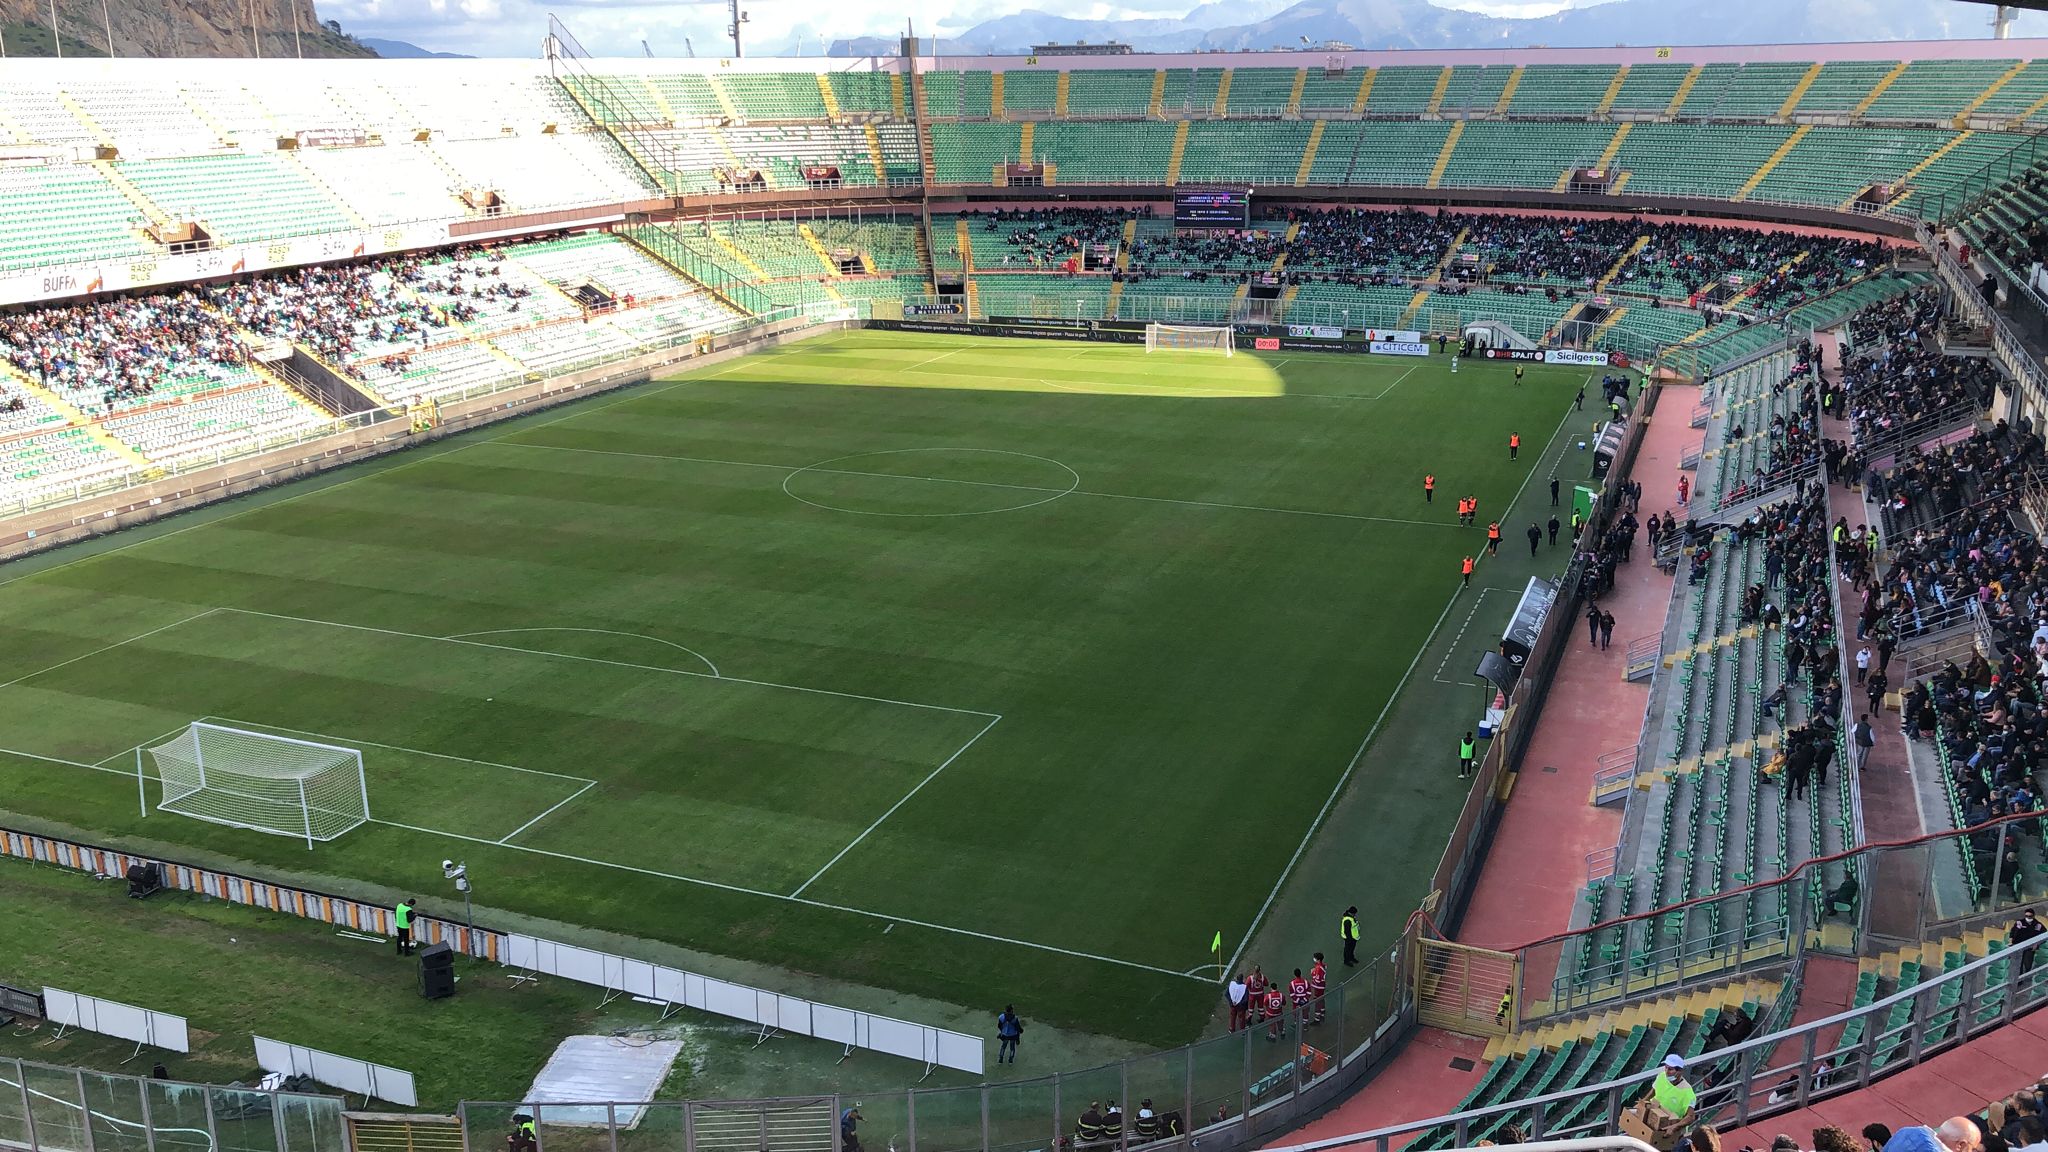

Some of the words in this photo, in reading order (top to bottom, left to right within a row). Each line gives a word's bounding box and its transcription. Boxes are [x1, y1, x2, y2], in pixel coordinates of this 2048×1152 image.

[1657, 50, 1669, 58] 28
[43, 275, 78, 294] BUFFA
[1382, 342, 1423, 352] CITICEM
[1495, 351, 1534, 359] BHRSPA.IT
[1557, 352, 1606, 362] Sicilgesso
